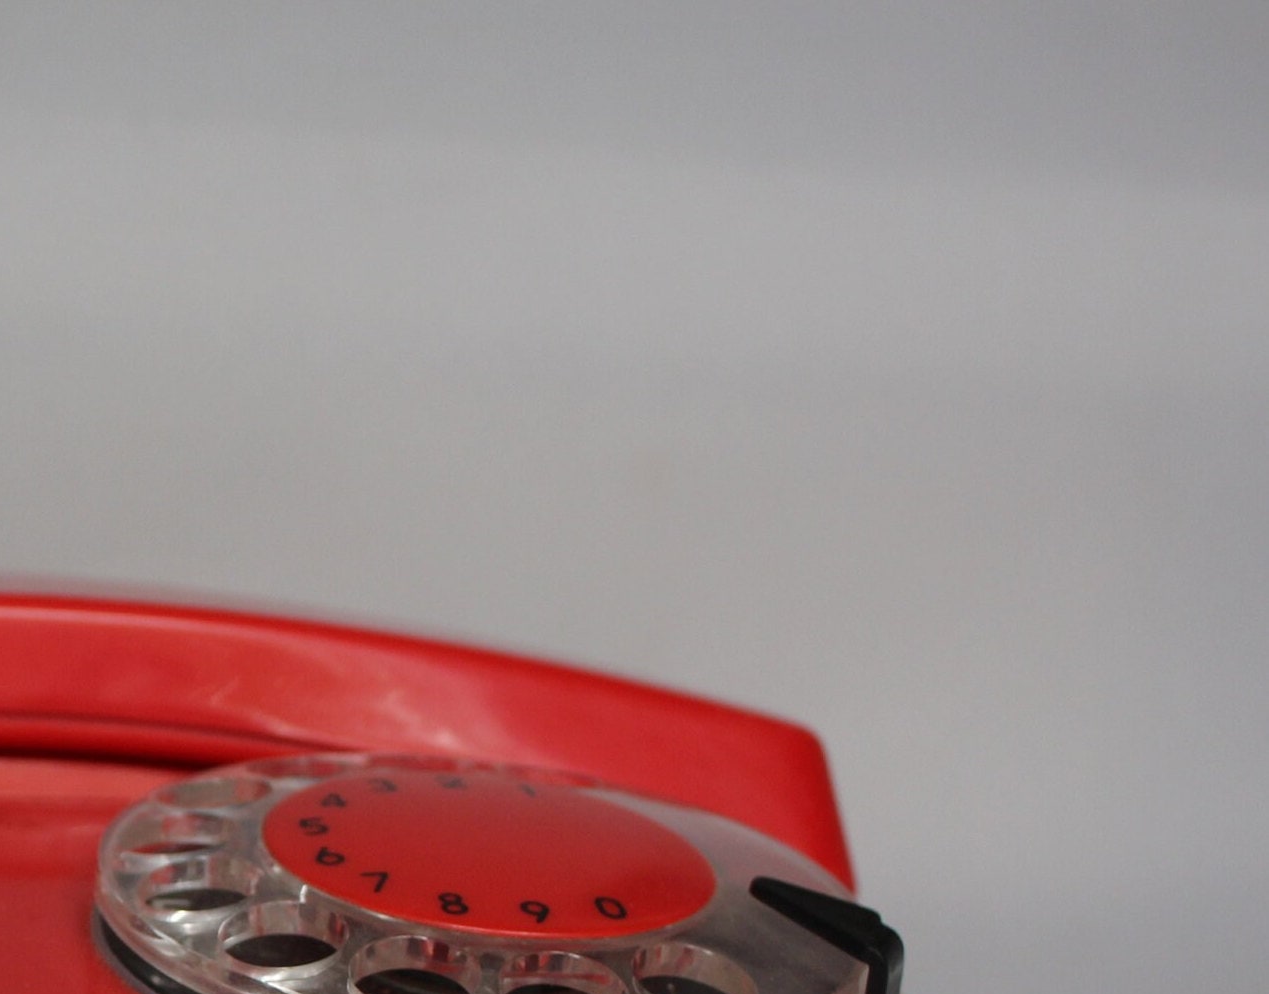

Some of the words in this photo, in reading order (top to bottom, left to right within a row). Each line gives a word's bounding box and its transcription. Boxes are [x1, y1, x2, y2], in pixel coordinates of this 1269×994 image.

[298, 816, 329, 837] 5
[315, 846, 346, 867] 6
[359, 871, 390, 894] 7
[437, 892, 470, 916] 8
[519, 899, 550, 924] 9
[594, 896, 628, 920] 0
